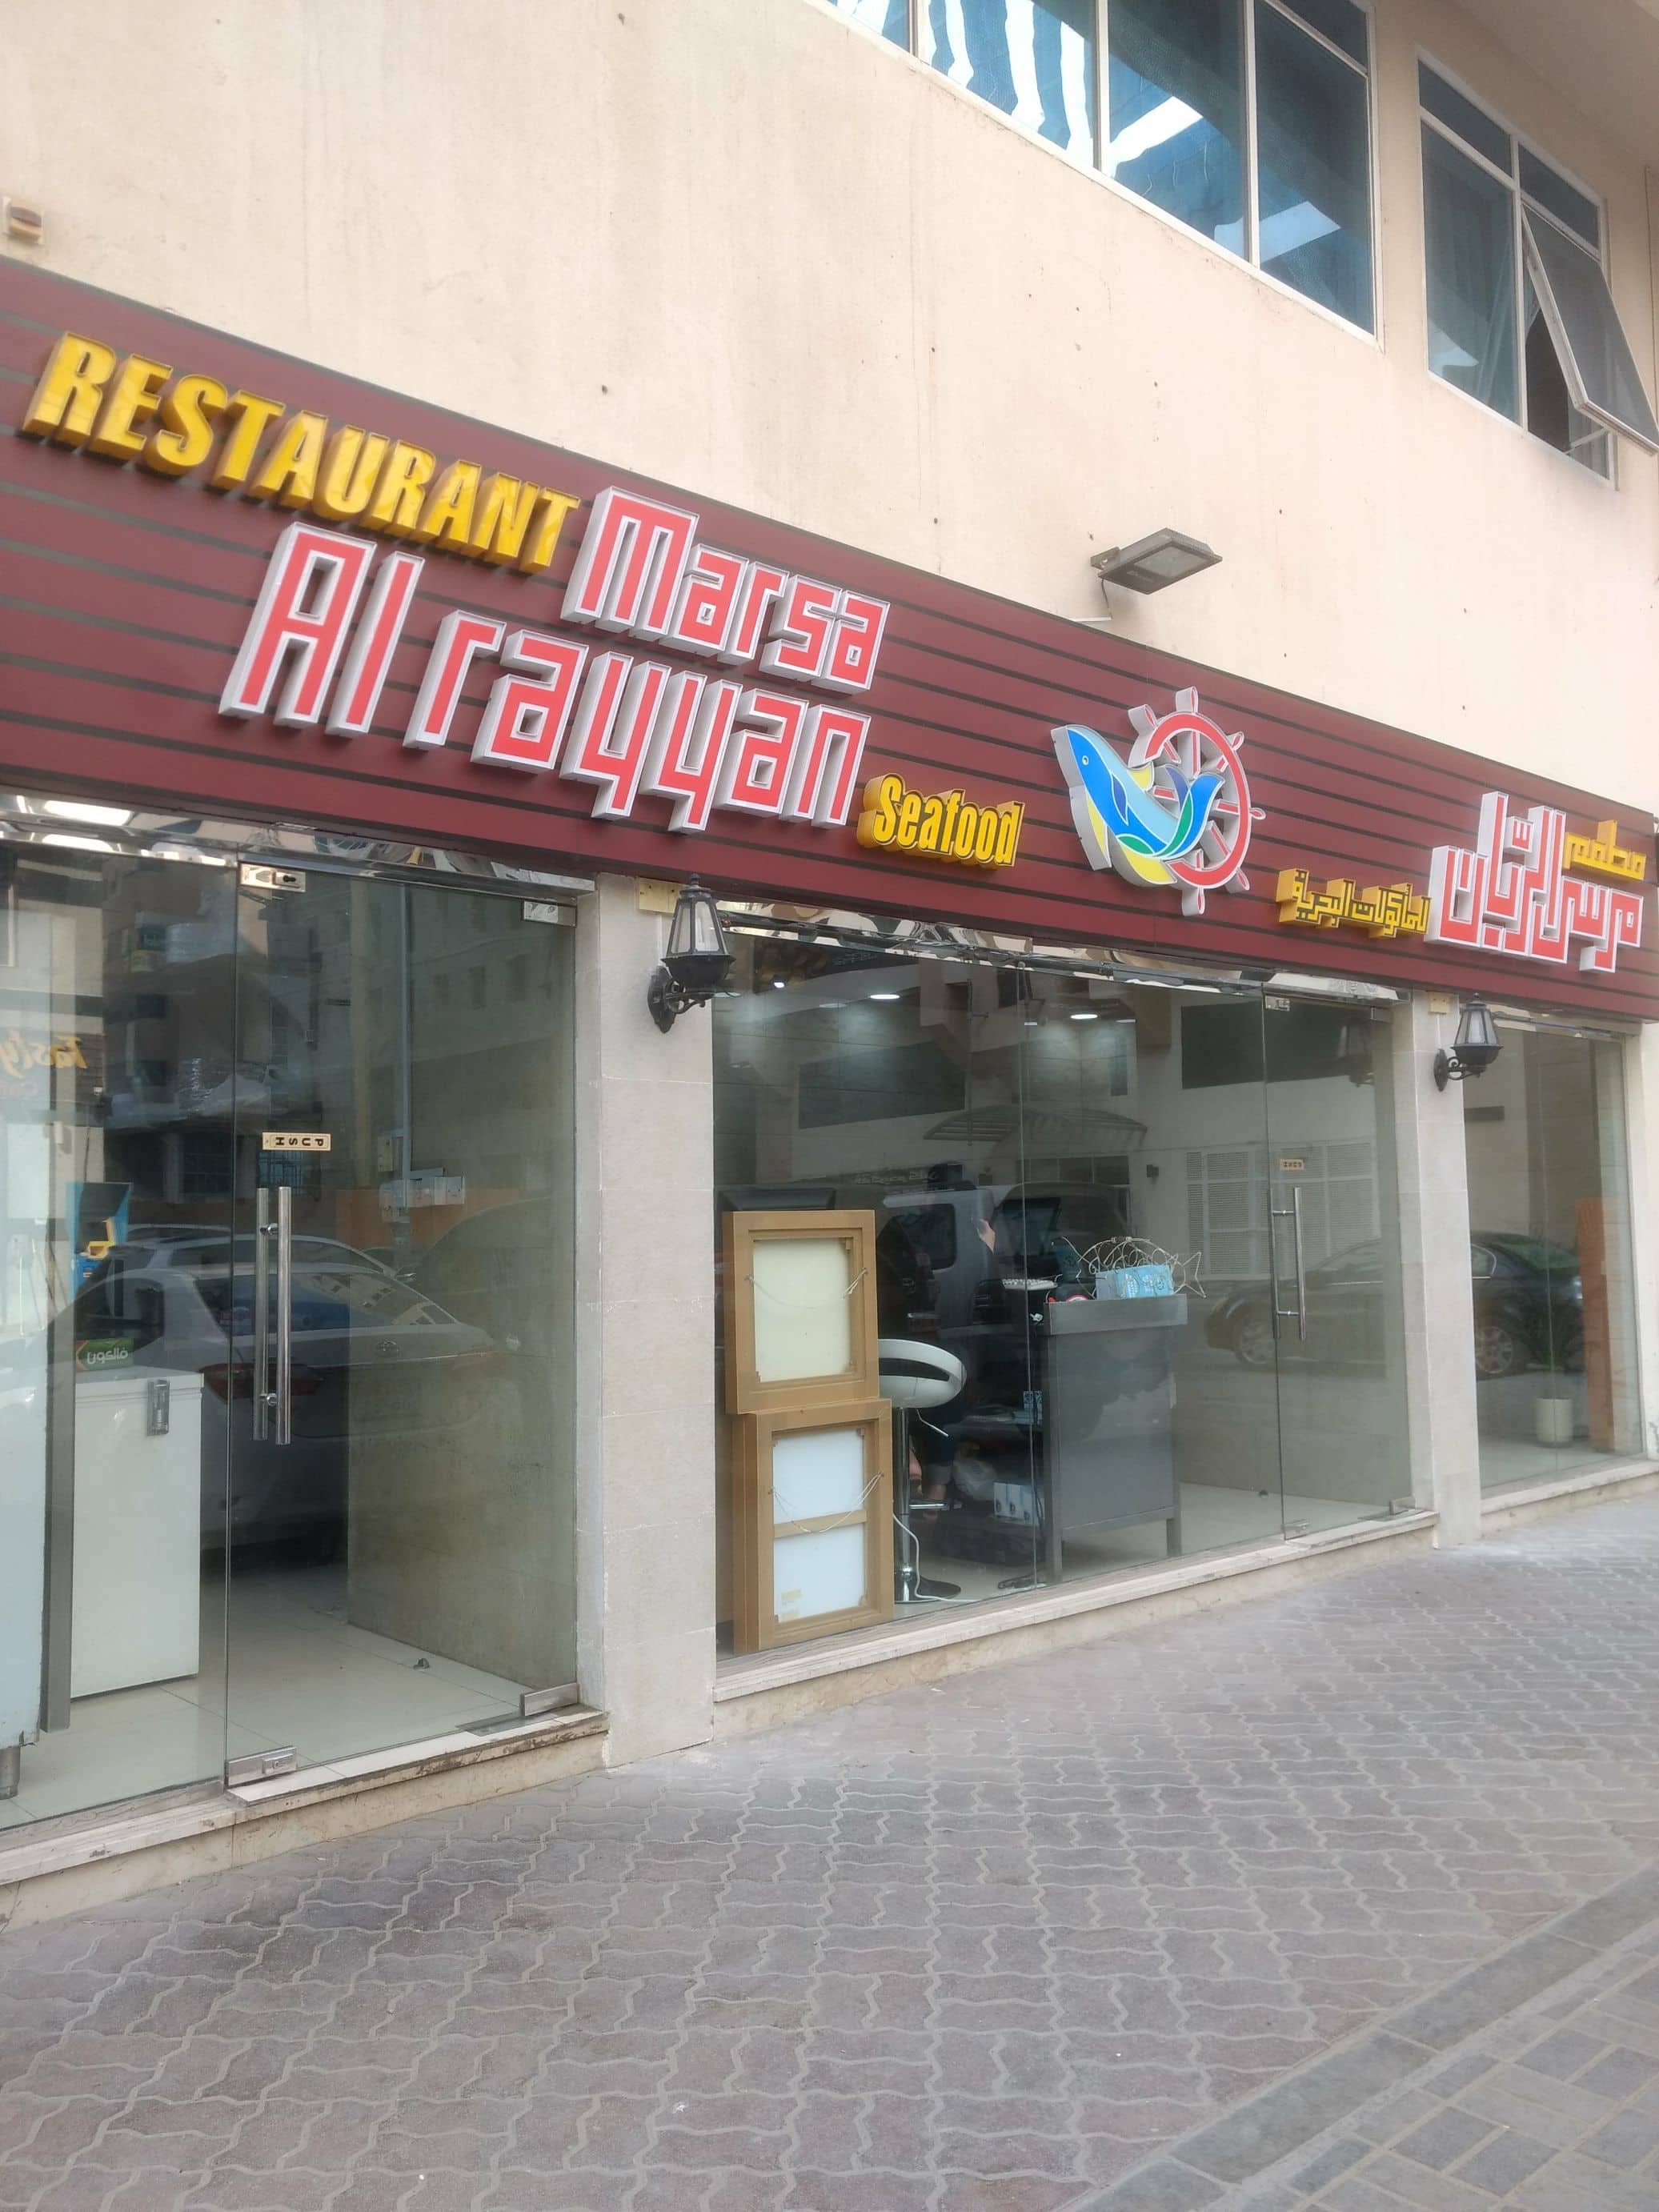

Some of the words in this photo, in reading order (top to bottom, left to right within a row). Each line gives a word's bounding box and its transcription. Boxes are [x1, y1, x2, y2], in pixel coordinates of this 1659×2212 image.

[23, 331, 581, 574] RESTAURANT
[560, 486, 891, 696] Marsa
[218, 522, 425, 736] Al
[403, 610, 872, 834] rayyan
[857, 773, 1025, 869] Seafood
[1563, 819, 1646, 880] مطعم
[275, 1136, 324, 1147] PUSH
[86, 1347, 129, 1364] فالكون
